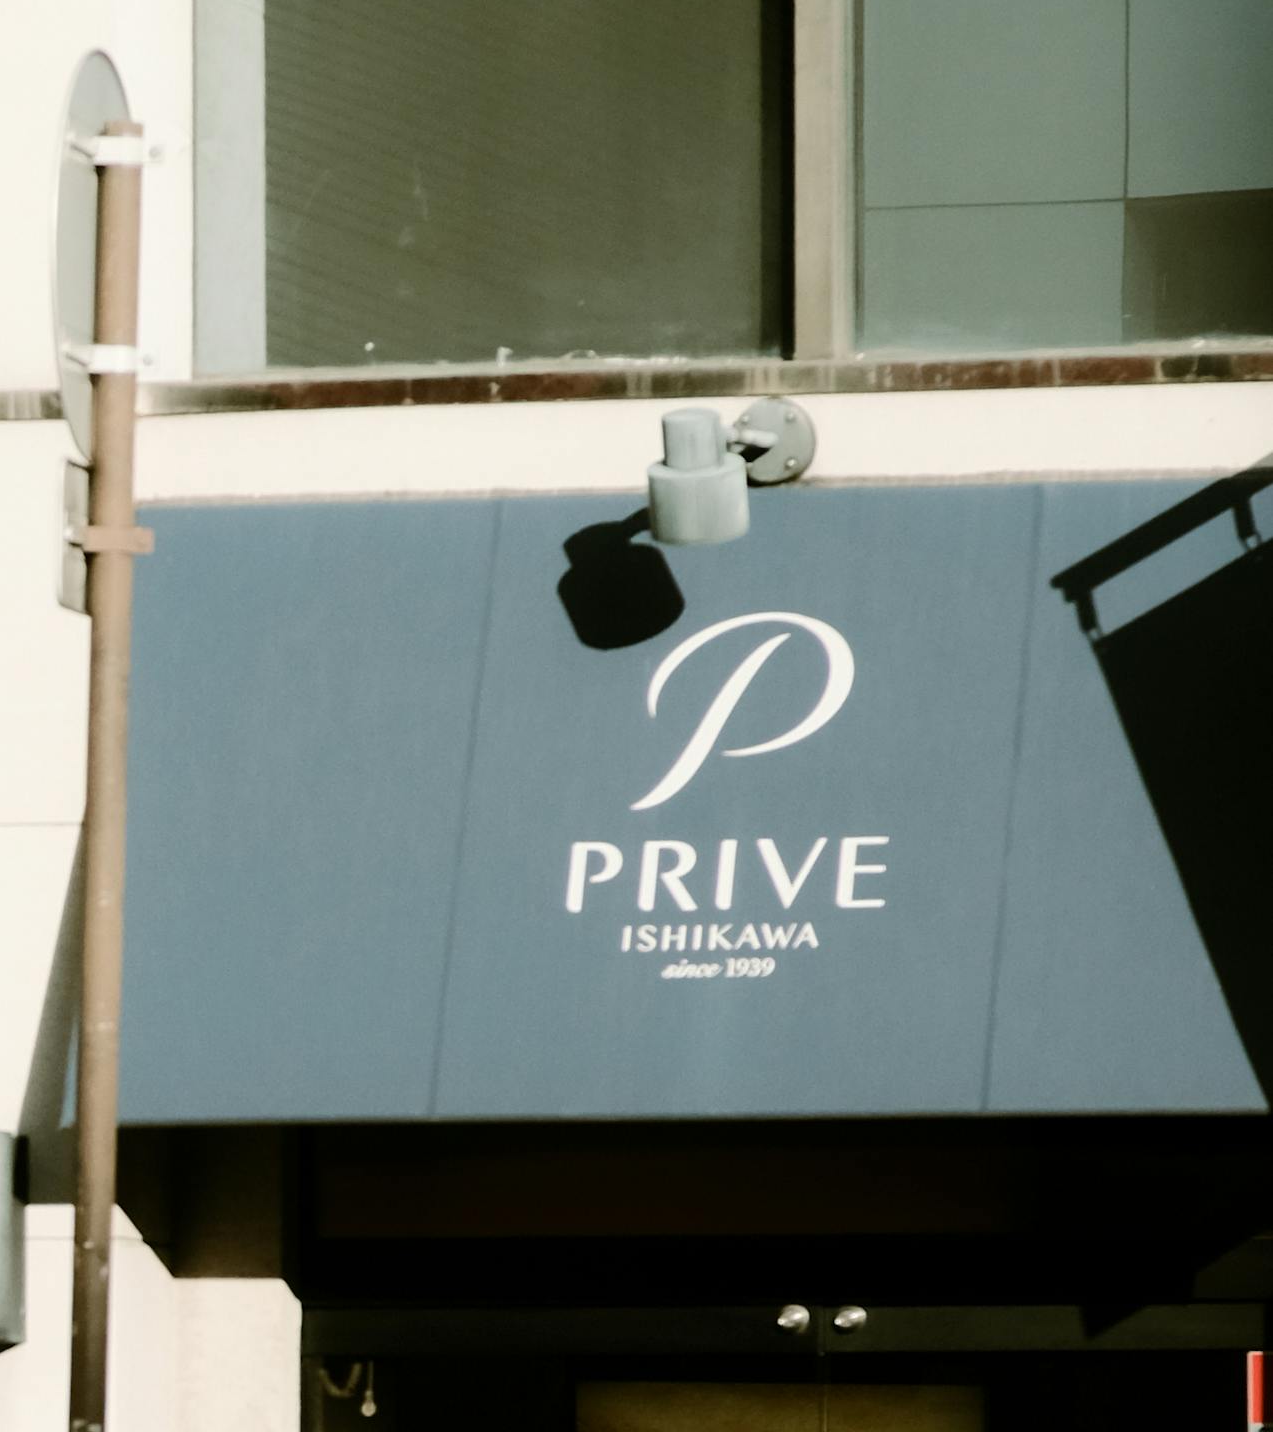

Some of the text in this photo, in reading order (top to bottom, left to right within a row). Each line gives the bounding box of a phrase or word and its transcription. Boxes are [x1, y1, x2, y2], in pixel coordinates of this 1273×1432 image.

[563, 835, 891, 914] PRIVE
[620, 921, 820, 953] ISHIKAWA
[660, 958, 776, 979] since 1939
